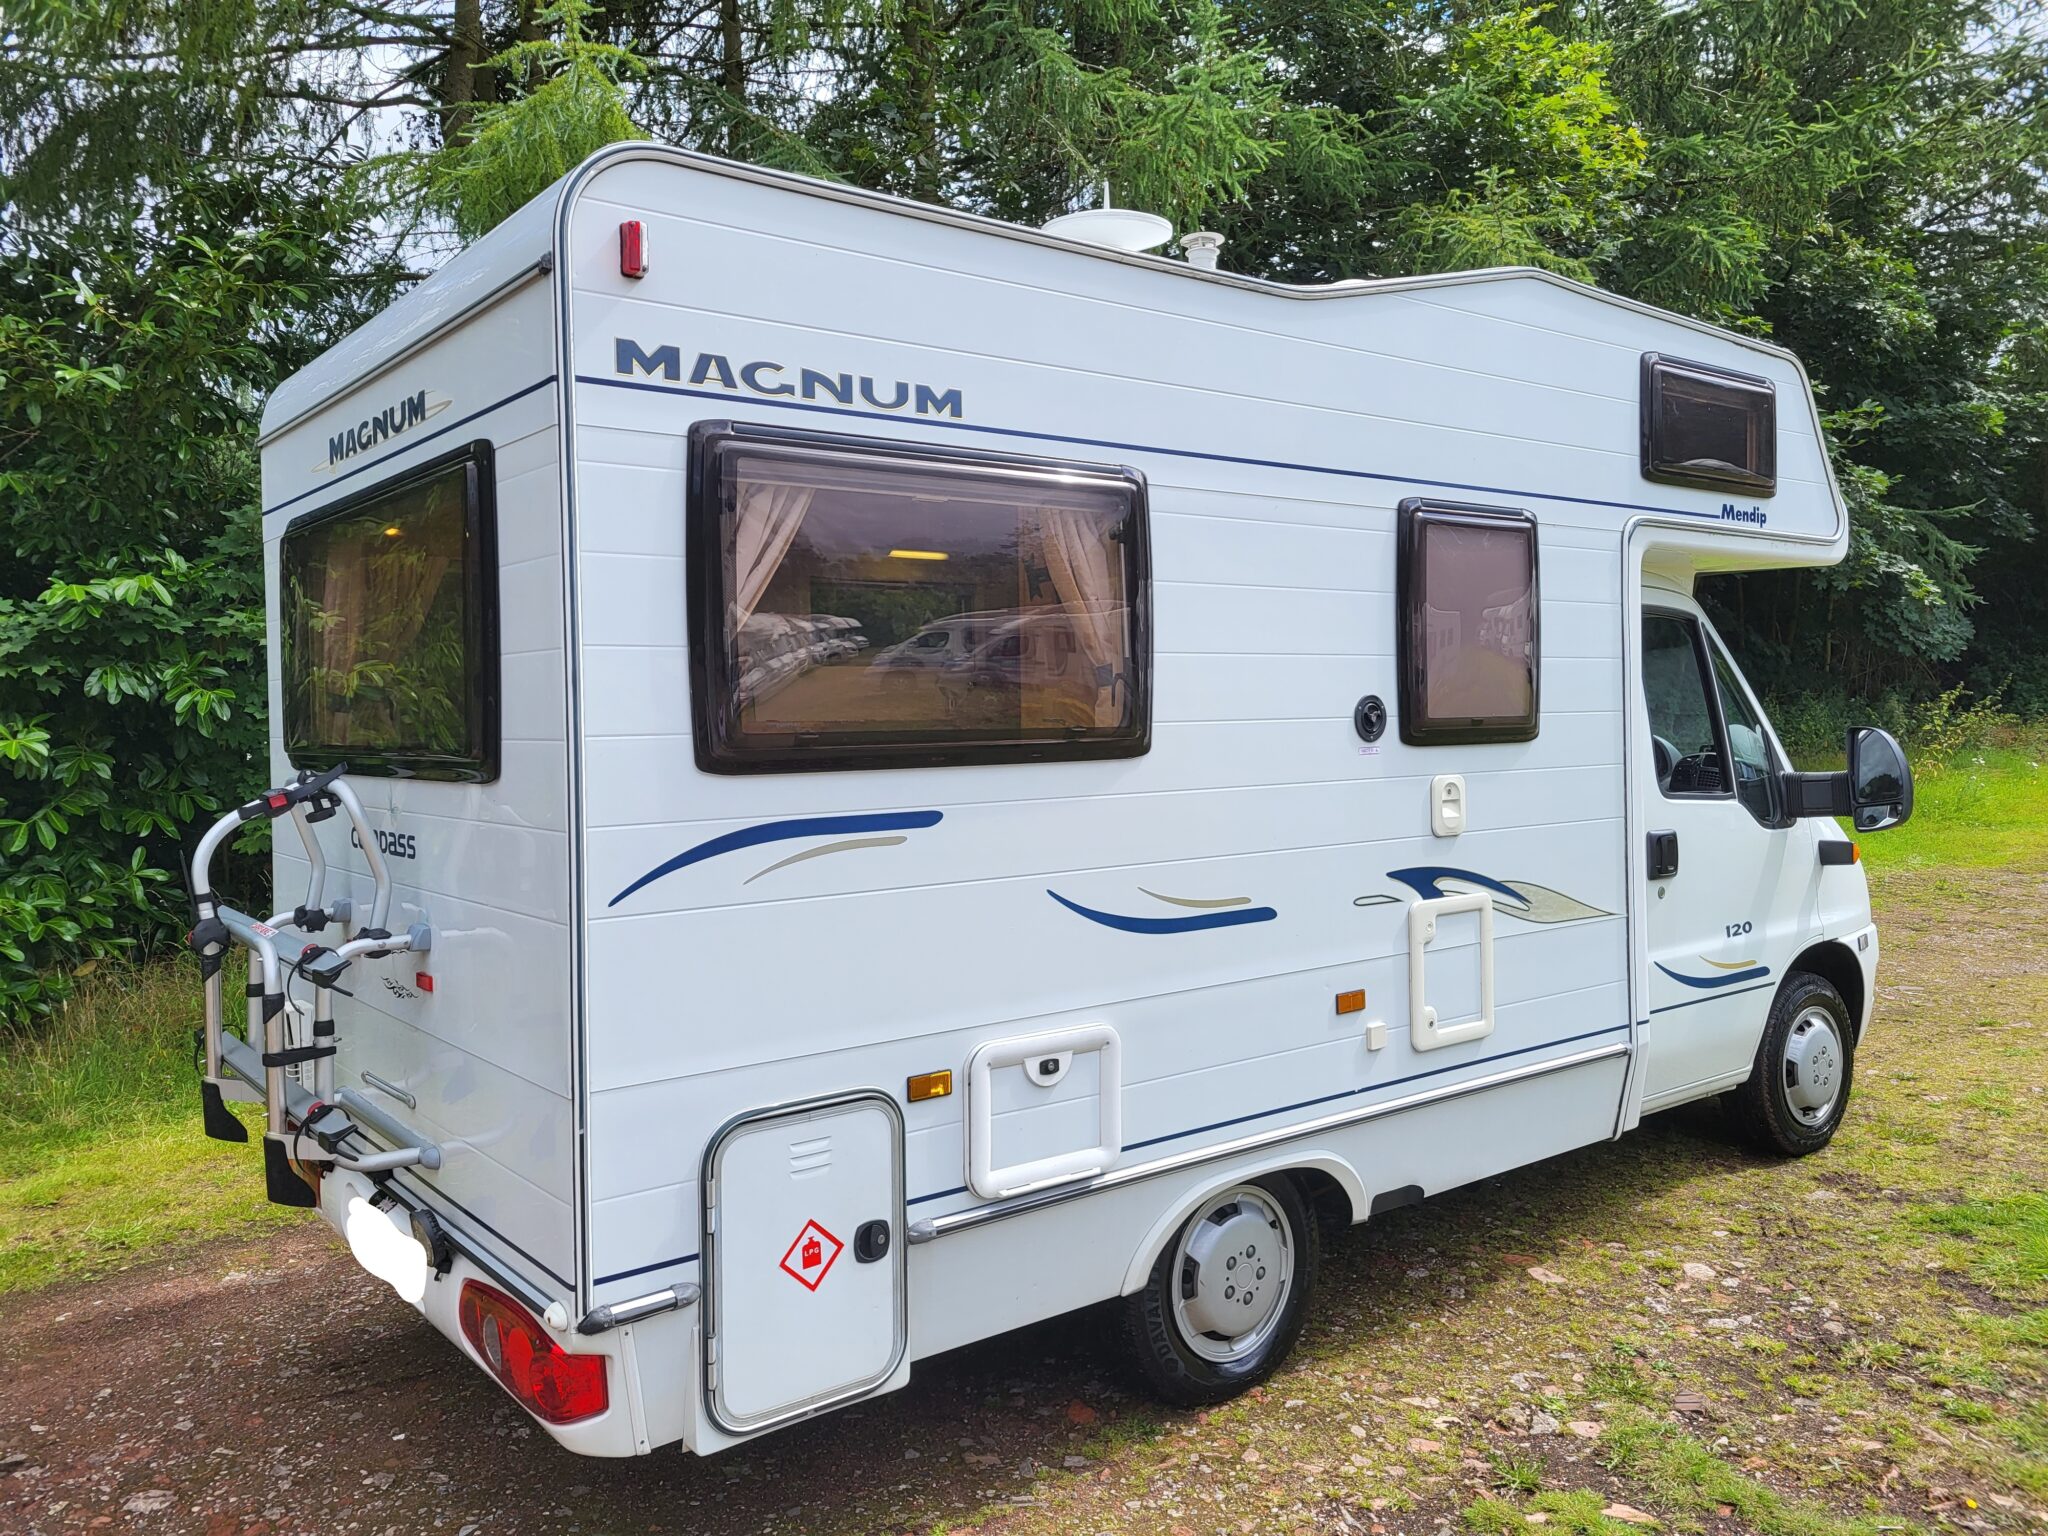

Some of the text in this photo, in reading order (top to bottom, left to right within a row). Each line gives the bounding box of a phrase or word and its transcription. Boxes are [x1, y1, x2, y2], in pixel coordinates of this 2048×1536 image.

[614, 336, 963, 419] MAGNUM
[329, 389, 426, 465] MAGNUM
[1721, 503, 1767, 528] Mendip
[351, 826, 416, 859] cpass
[1725, 920, 1753, 938] 120
[804, 1246, 820, 1257] LPG
